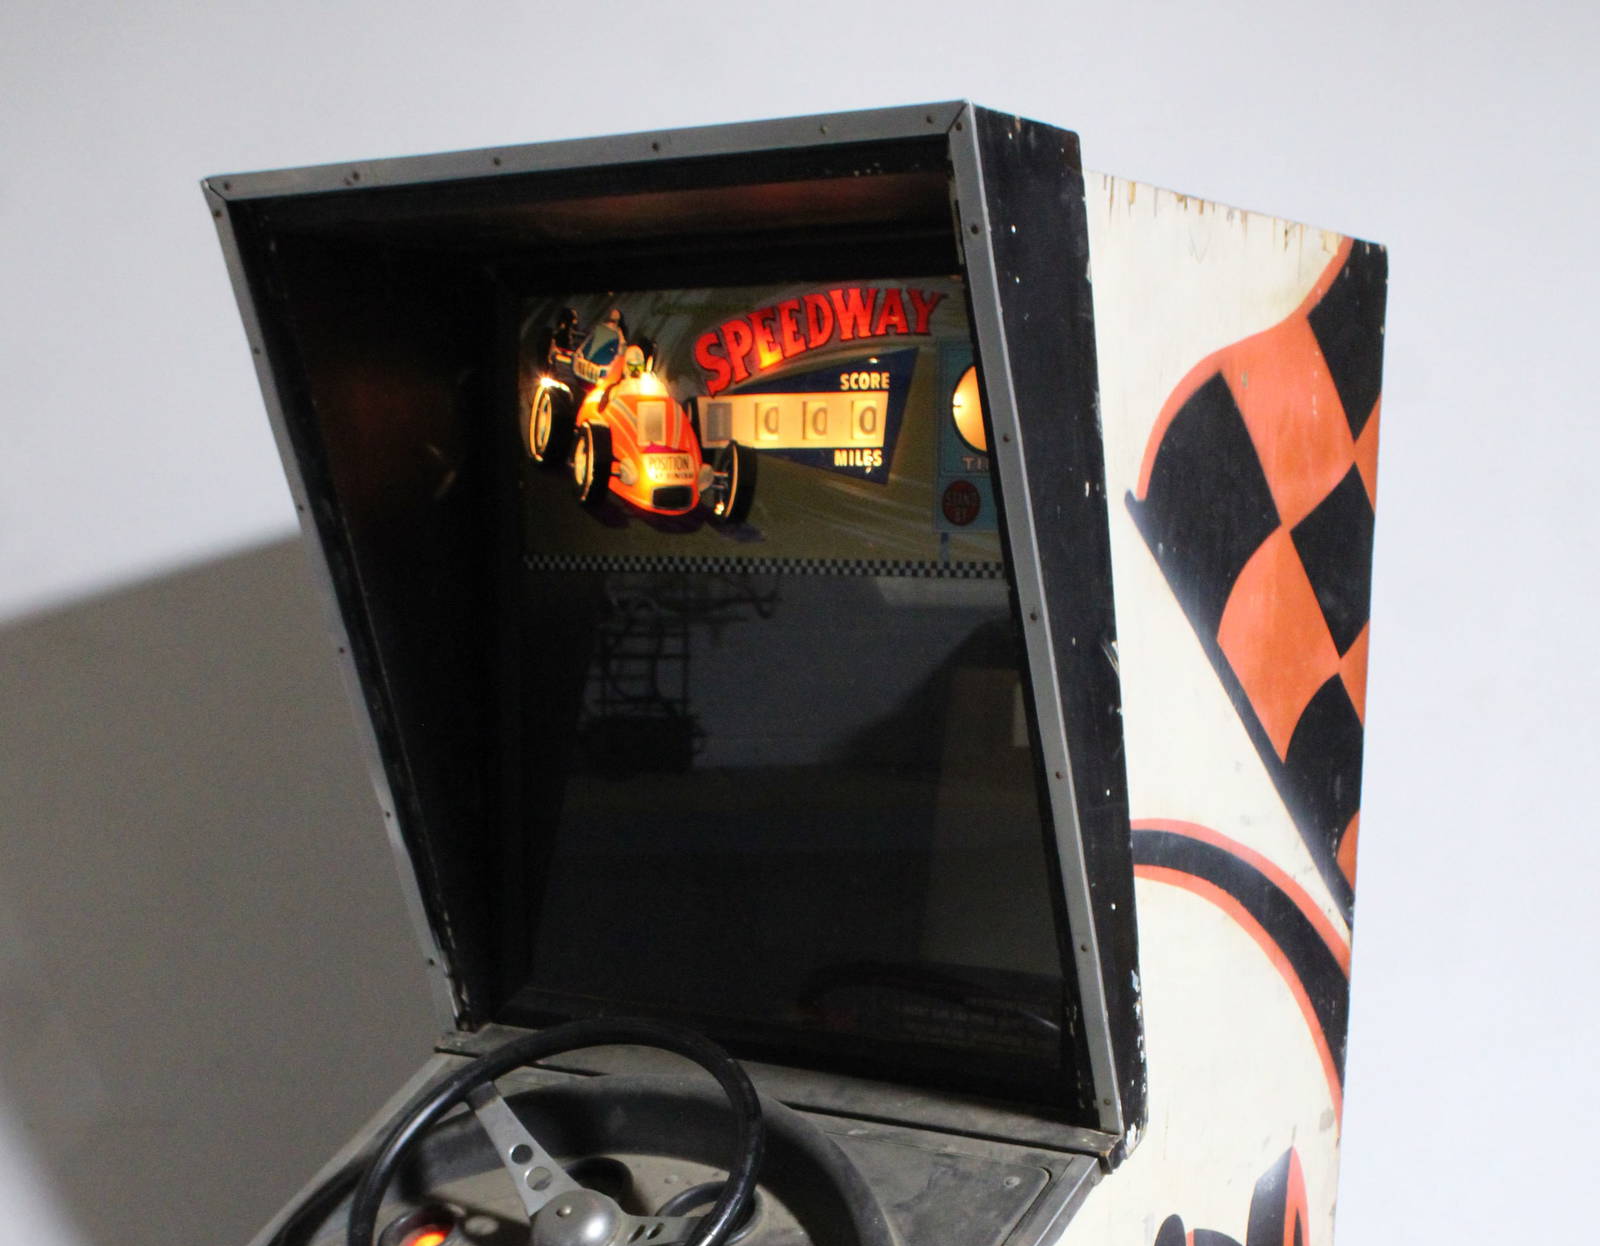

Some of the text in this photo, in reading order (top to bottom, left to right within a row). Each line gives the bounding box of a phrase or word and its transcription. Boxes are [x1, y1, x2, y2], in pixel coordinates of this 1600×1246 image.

[694, 287, 947, 397] SPEEDWAY
[840, 372, 890, 390] SCORE
[834, 449, 882, 467] MILES
